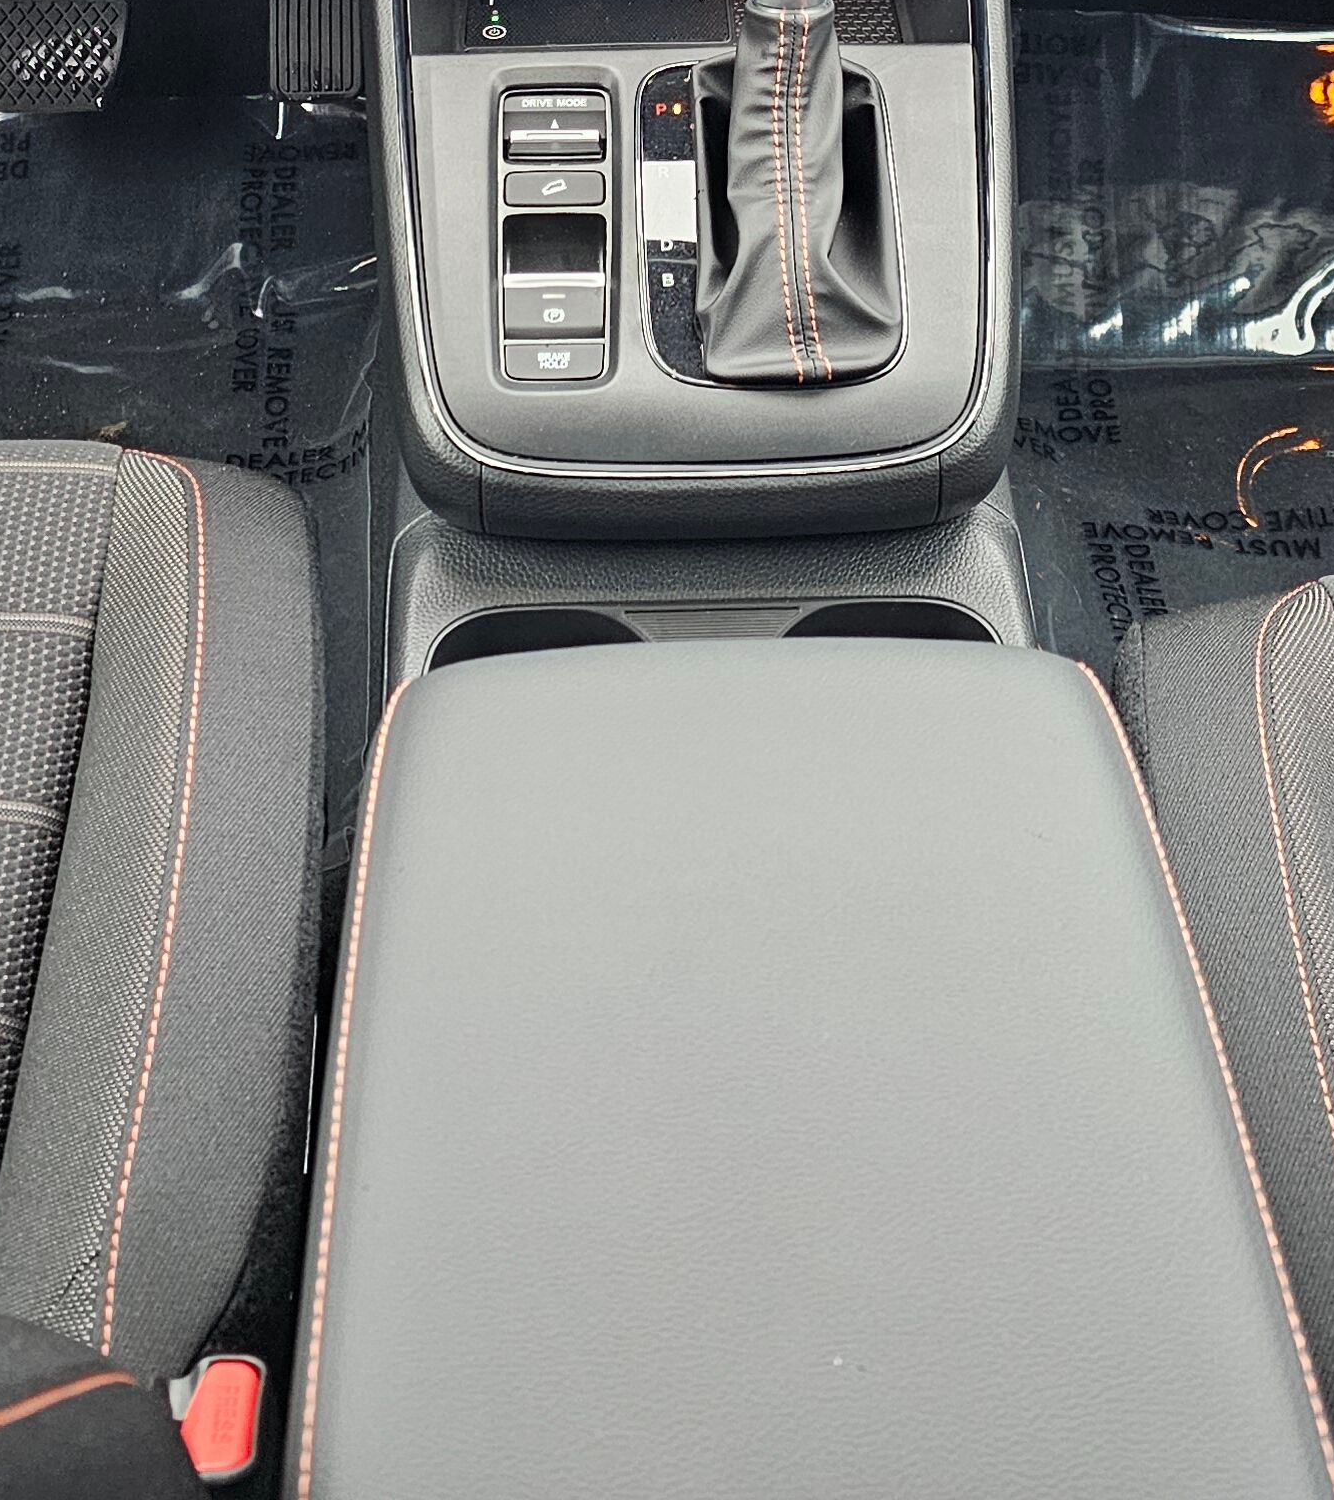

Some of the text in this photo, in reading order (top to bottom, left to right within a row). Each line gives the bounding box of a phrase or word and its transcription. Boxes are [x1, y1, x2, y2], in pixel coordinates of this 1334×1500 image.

[522, 98, 587, 108] DRIVE MODE
[655, 103, 667, 115] P
[660, 238, 674, 252] D
[661, 273, 675, 287] B
[537, 352, 571, 361] BRAKE
[539, 360, 569, 369] HOLD
[1143, 507, 1249, 534] COVER
[1233, 537, 1320, 561] MUST
